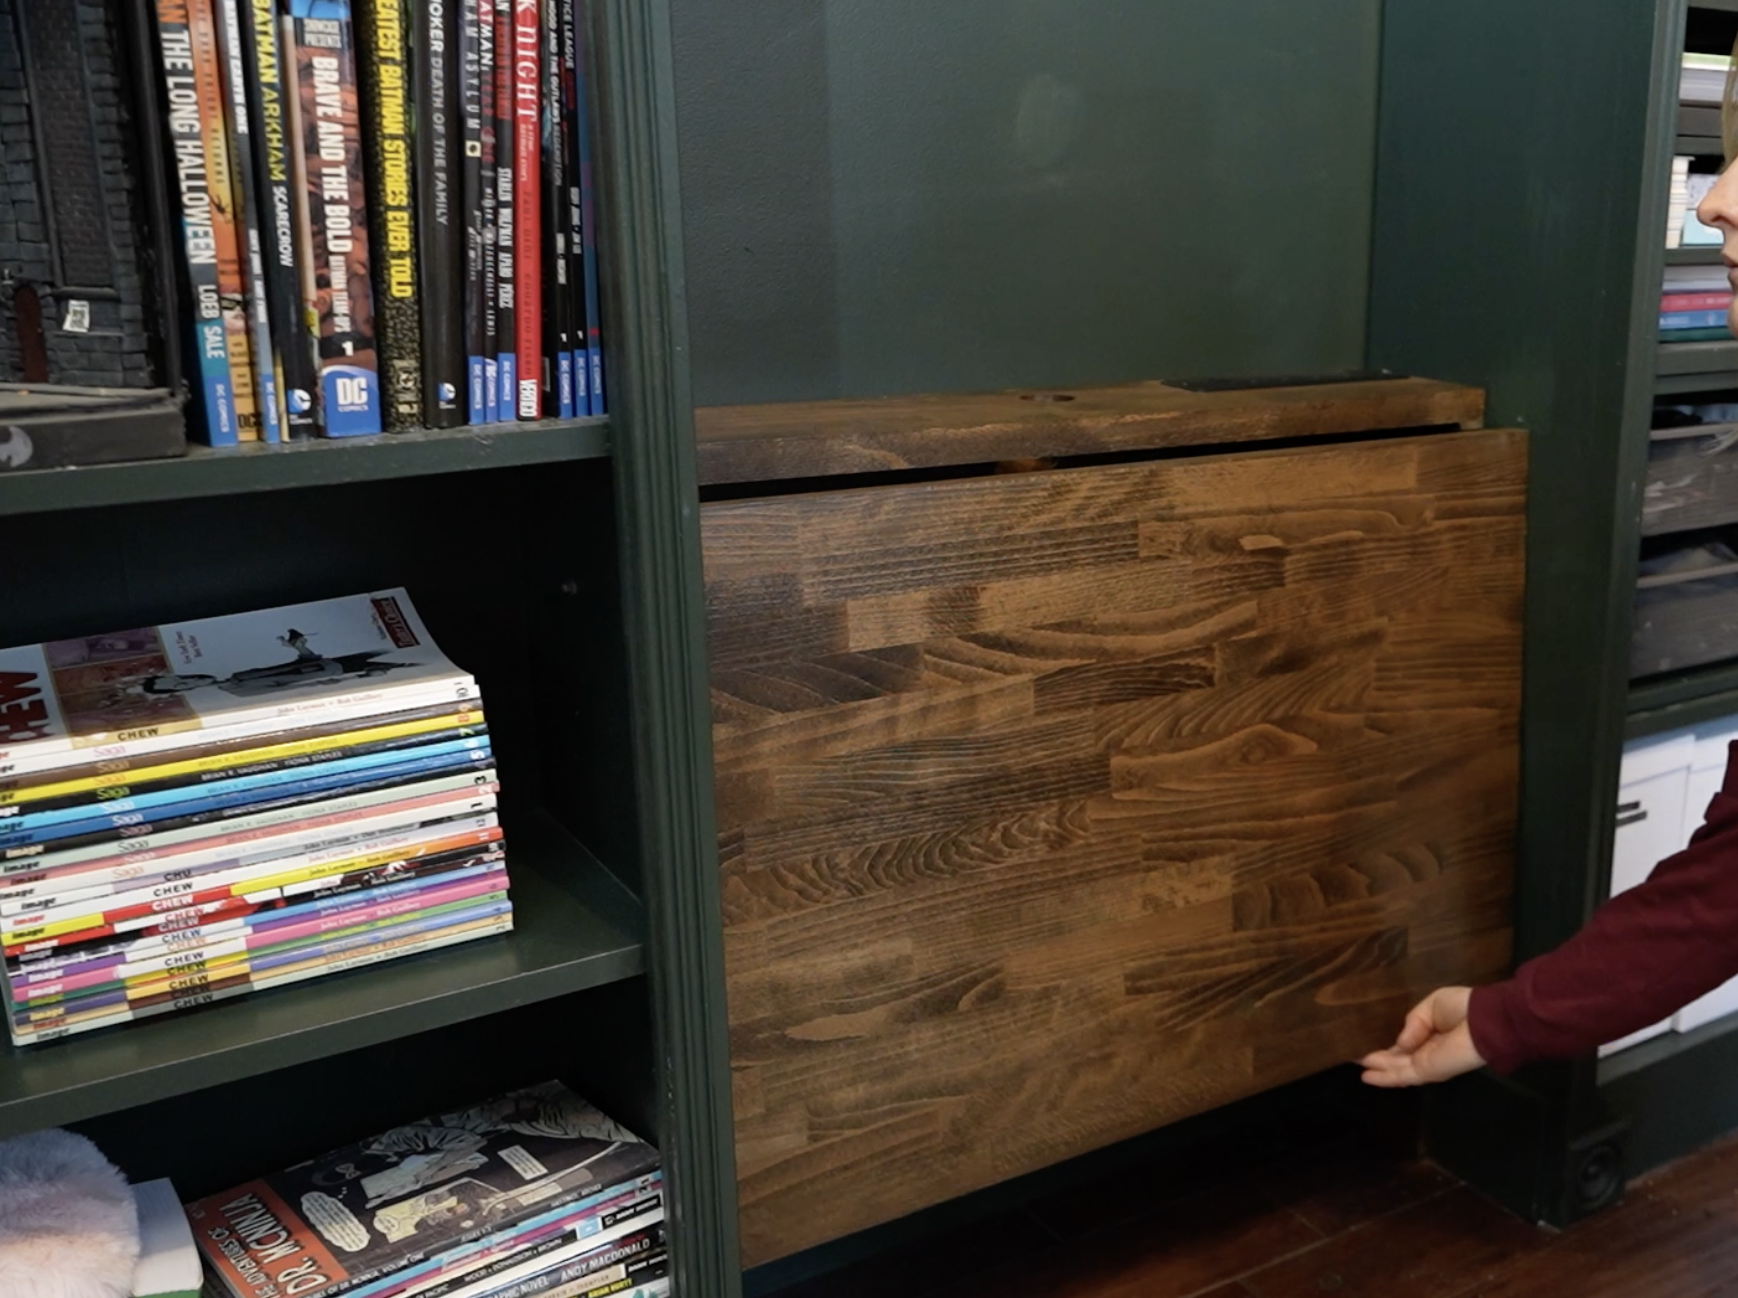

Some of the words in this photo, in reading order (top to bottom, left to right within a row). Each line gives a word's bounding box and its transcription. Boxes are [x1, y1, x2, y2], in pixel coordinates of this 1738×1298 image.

[160, 29, 195, 72] THE
[253, 0, 279, 83] BATMAN
[548, 32, 559, 54] AND
[564, 26, 575, 69] LEAGUE
[516, 25, 538, 122] NIGHT
[550, 56, 559, 74] THE
[312, 56, 343, 117] BRAVE
[430, 55, 444, 108] DEATH
[465, 51, 481, 129] ASYLUM
[166, 76, 201, 134] LONG
[379, 64, 405, 135] BATMAN
[235, 106, 249, 134] ONE
[260, 87, 287, 181] ARKHAM
[432, 112, 446, 133] OF
[210, 127, 226, 185] RETURNS
[317, 120, 346, 161] AND
[433, 137, 447, 168] THE
[321, 165, 350, 201] THE
[383, 140, 409, 207] STORIES
[173, 140, 218, 264] HALLOWEEN
[434, 171, 449, 225] FAMILY
[272, 186, 293, 267] SCARECROW
[323, 205, 353, 253] BOLD
[386, 210, 411, 252] EVER
[390, 256, 412, 297] TOLD
[498, 251, 513, 278] APARO
[198, 284, 221, 319] LOEB
[203, 325, 226, 359] SALE
[341, 341, 354, 356] 1
[335, 377, 368, 405] DC
[519, 379, 538, 418] VERTIGO
[117, 727, 159, 742] CHEW
[470, 750, 485, 759] 5
[474, 776, 487, 785] 3
[112, 812, 144, 827] Saga
[117, 839, 150, 854] Saga
[4, 861, 40, 873] image
[163, 869, 192, 882] CHU
[21, 898, 56, 910] image
[152, 894, 194, 911] CHEW
[153, 881, 194, 898] CHEW
[12, 926, 46, 939] image
[162, 928, 202, 944] CHEW
[164, 951, 205, 967] CHEW
[167, 960, 207, 976] CHEW
[169, 973, 209, 990] CHEW
[174, 993, 214, 1010] CHEW
[208, 1226, 230, 1240] OF
[219, 1193, 302, 1265] MCNINJA
[218, 1238, 268, 1285] ADVENTURES
[408, 1252, 425, 1263] ONE
[560, 1263, 591, 1283] ANDY
[590, 1239, 651, 1269] MACDONALD
[277, 1256, 328, 1295] DR.
[519, 1274, 550, 1294] NOVEL
